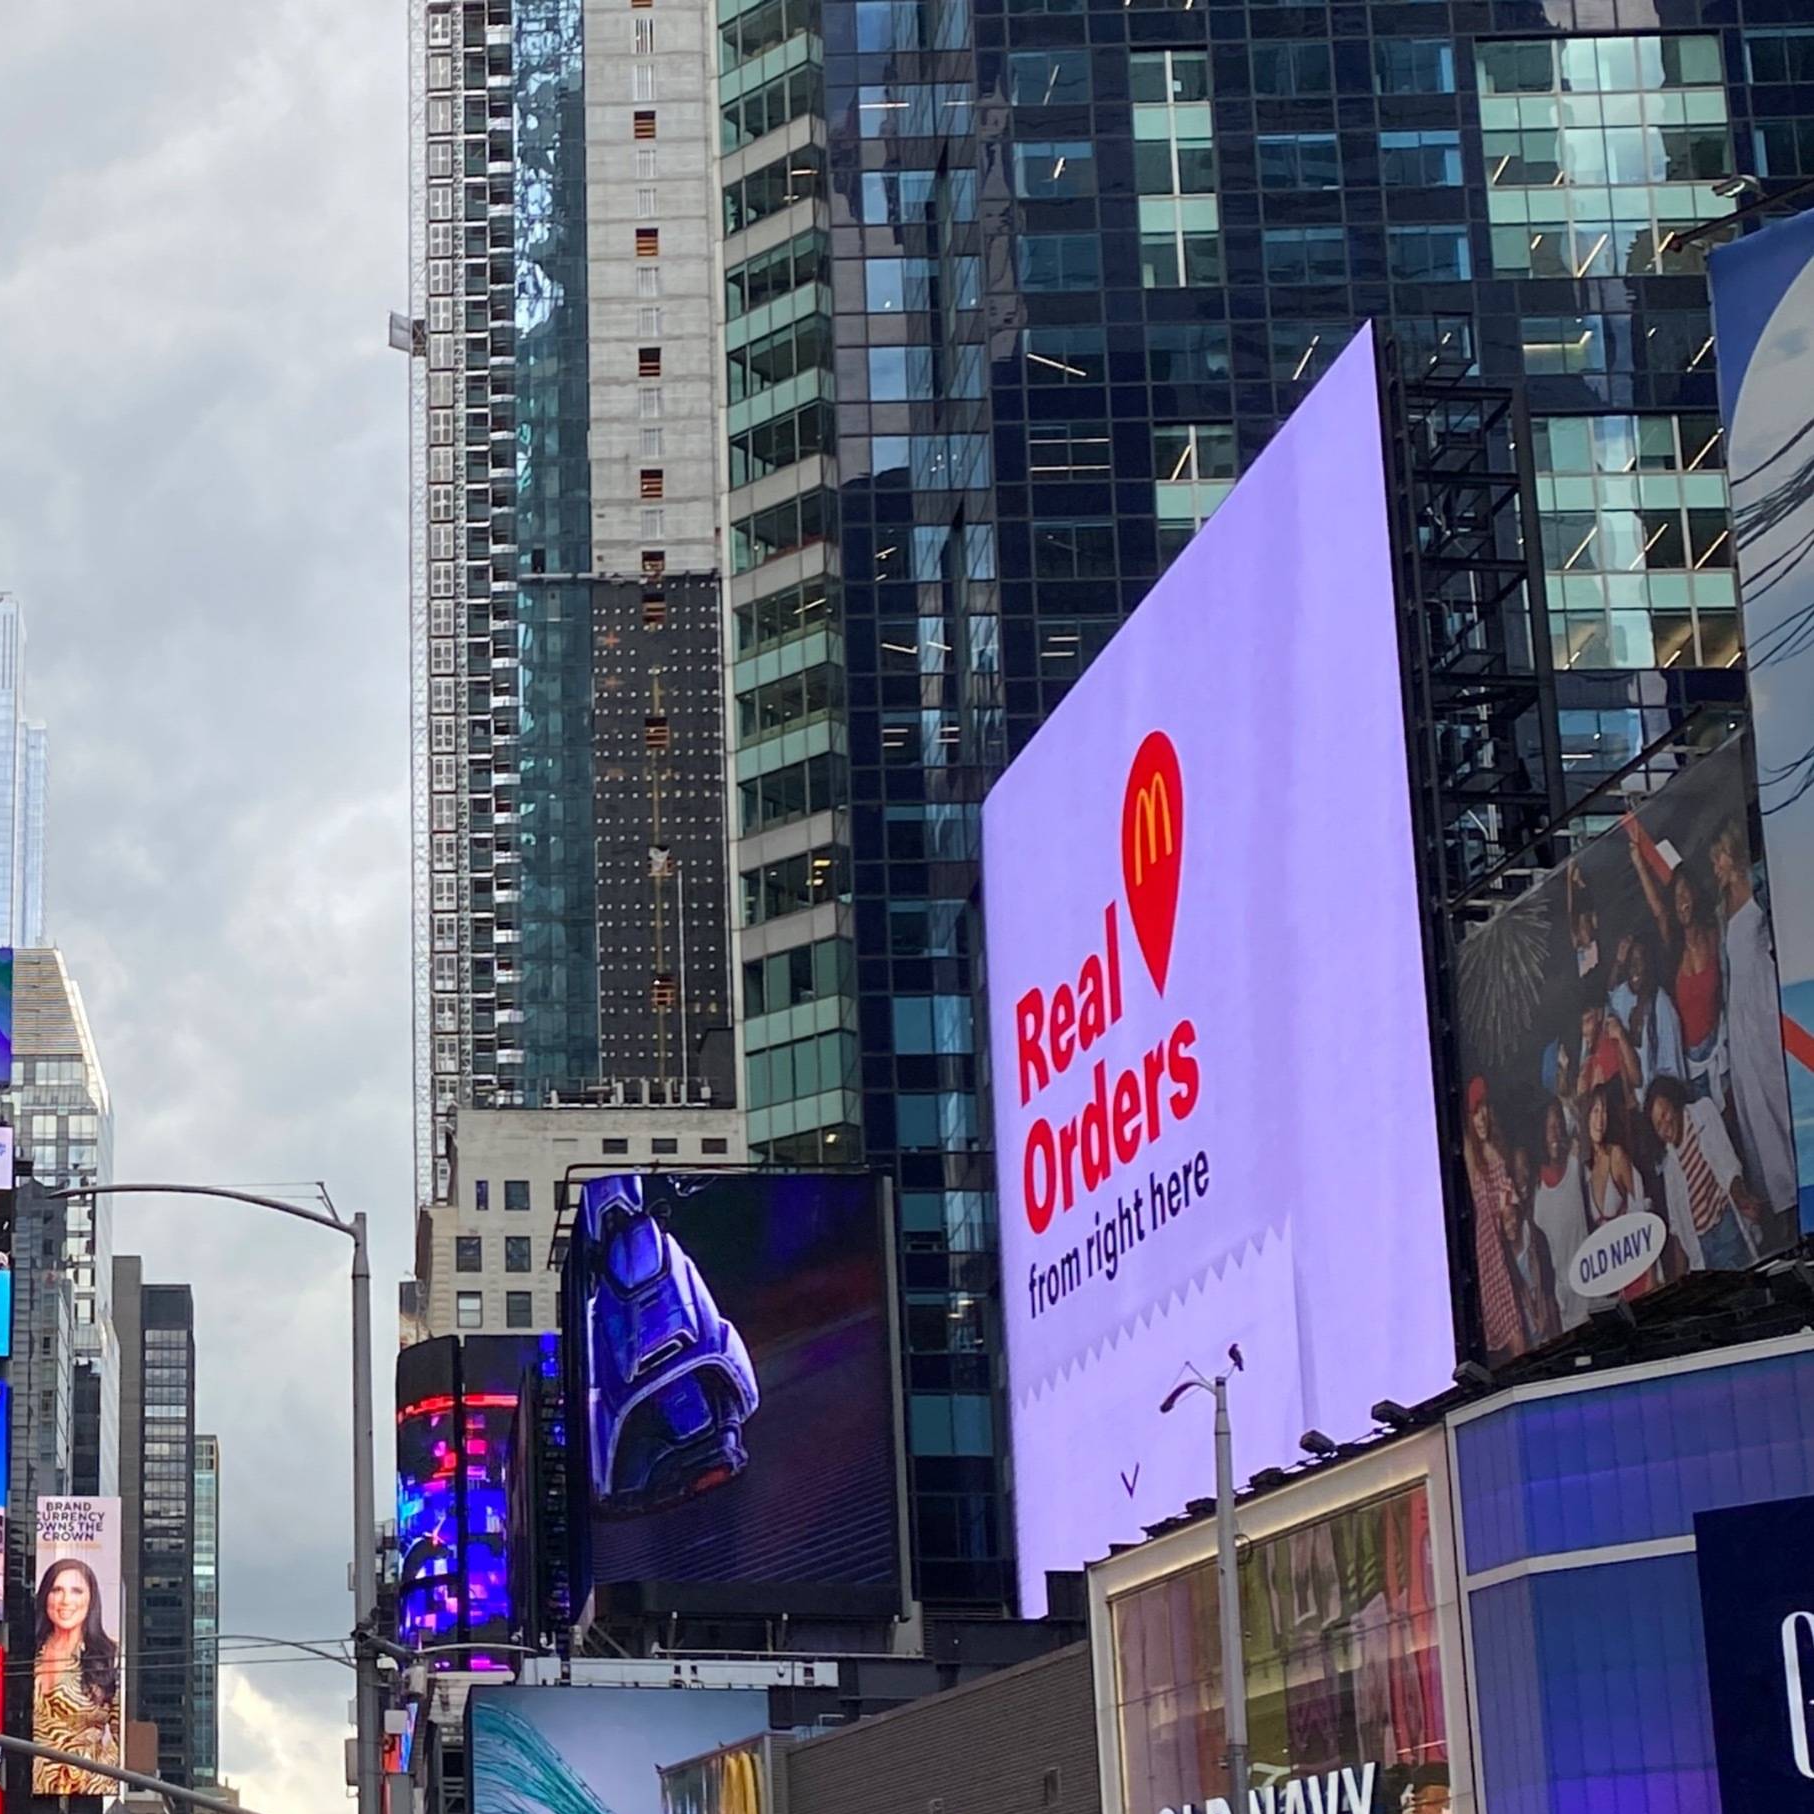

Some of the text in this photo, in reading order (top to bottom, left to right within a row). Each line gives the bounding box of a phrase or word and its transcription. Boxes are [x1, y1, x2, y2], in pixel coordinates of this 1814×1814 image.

[1016, 899, 1122, 1108] Real
[1023, 1019, 1200, 1235] Orders
[1028, 1150, 1210, 1319] from right here
[1579, 1224, 1653, 1284] OLD NAVY
[42, 1532, 95, 1542] CROWN
[45, 1502, 92, 1512] BRAND
[78, 1521, 104, 1532] THE
